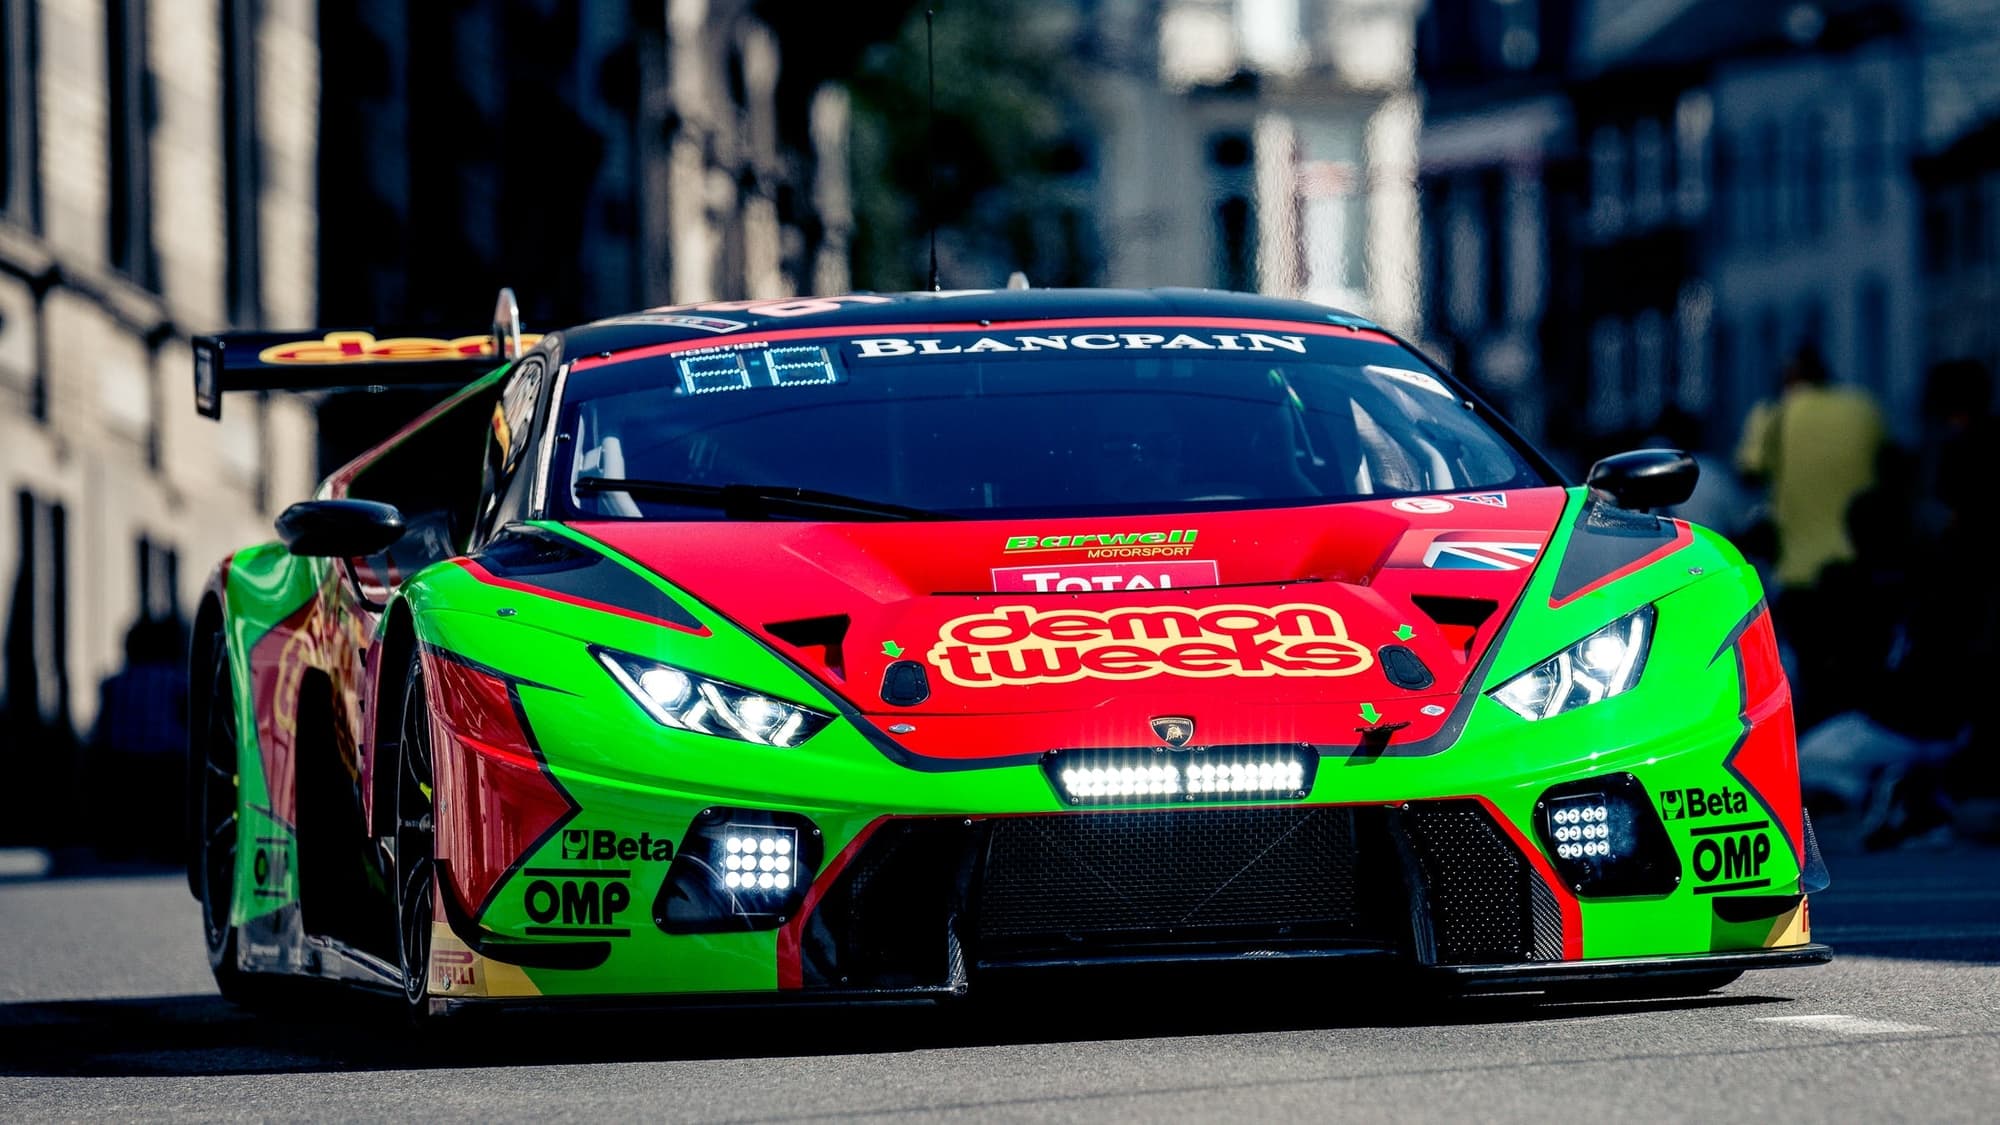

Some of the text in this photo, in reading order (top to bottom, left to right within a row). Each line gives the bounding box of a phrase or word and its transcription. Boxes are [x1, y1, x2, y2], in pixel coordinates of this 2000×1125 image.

[671, 341, 768, 358] POSITION
[851, 333, 1306, 358] BLANCPAIN
[1005, 529, 1199, 550] Barwell
[1087, 546, 1191, 559] MOTORSPORT
[948, 606, 1339, 646] demon
[940, 638, 1364, 682] tweeks
[1686, 786, 1748, 818] Beta
[592, 829, 674, 862] Beta
[1692, 832, 1771, 882] OMP
[524, 879, 631, 925] OMP
